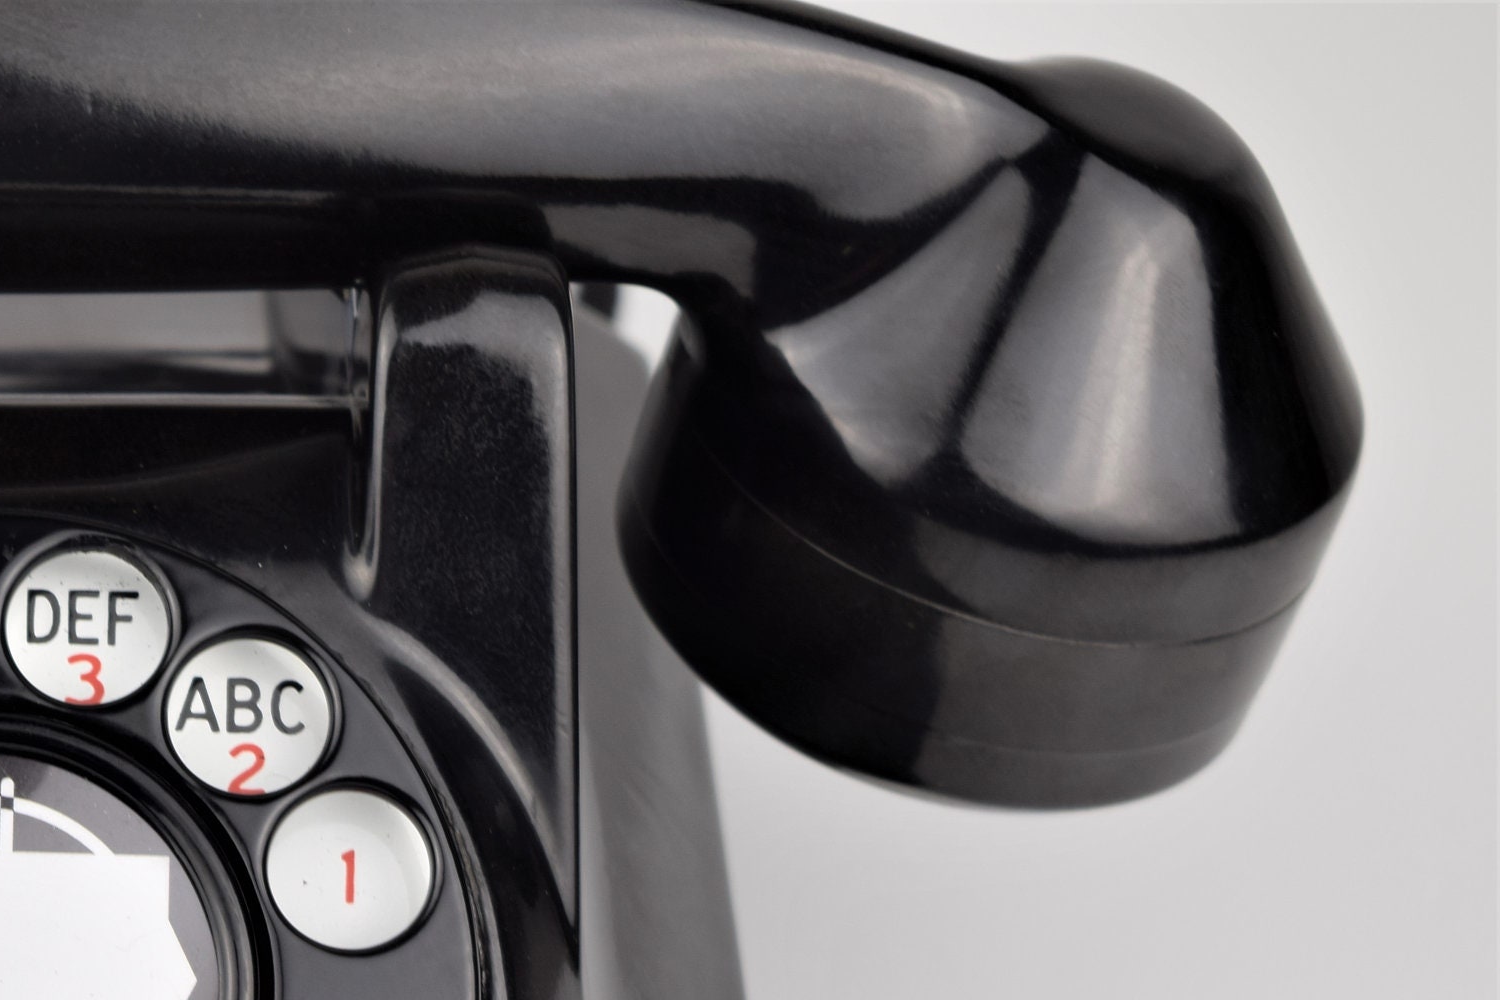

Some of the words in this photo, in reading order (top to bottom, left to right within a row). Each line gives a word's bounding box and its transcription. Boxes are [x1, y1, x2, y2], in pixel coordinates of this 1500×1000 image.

[26, 589, 140, 646] DEF
[66, 653, 105, 706] 3
[176, 676, 305, 735] ABC
[228, 743, 265, 796] 2
[341, 850, 356, 904] 1
